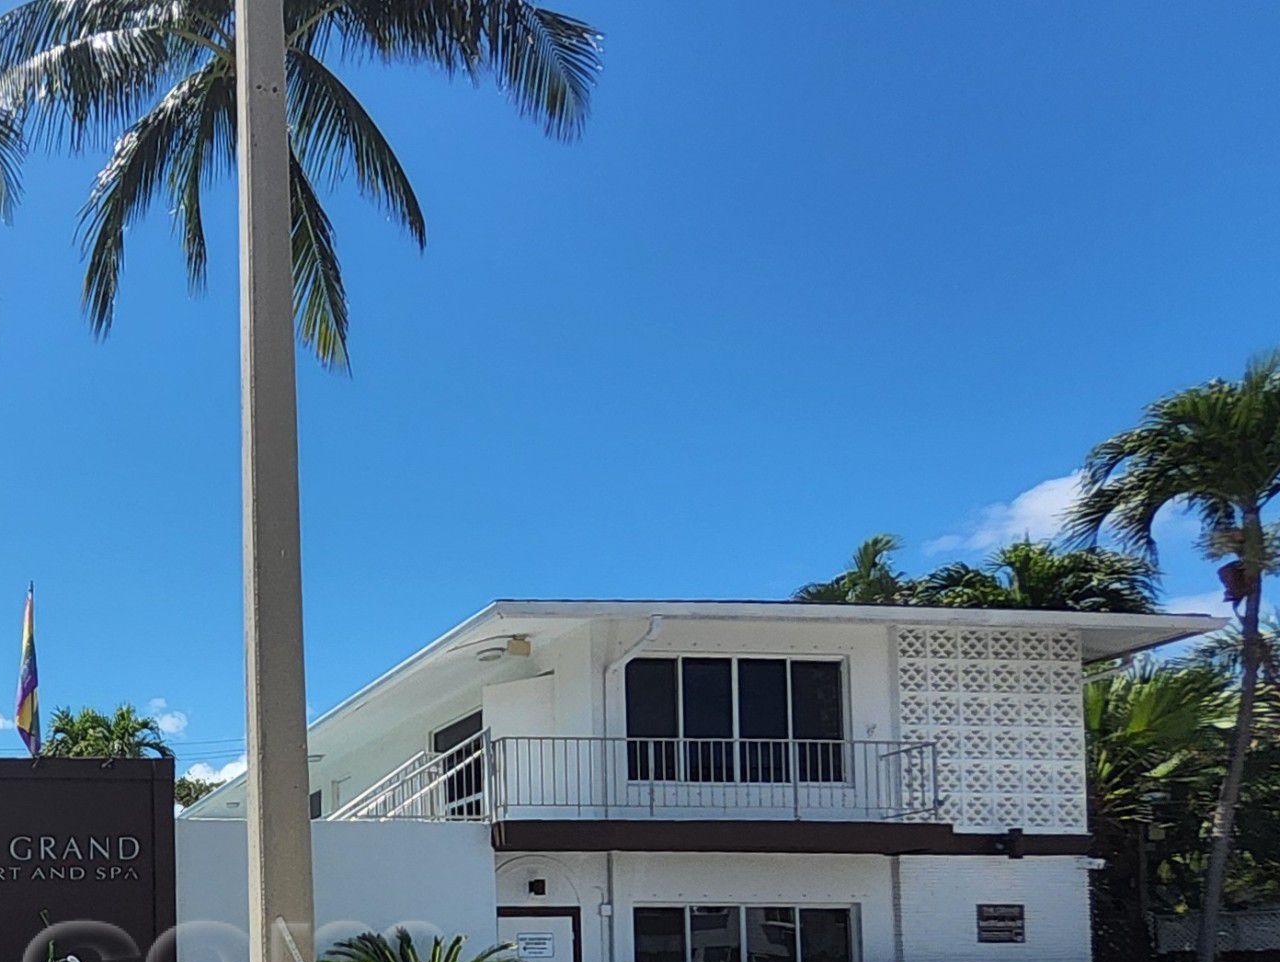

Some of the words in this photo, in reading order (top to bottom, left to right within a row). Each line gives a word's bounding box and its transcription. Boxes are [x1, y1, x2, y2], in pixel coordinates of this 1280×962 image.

[9, 836, 140, 861] GRAND
[31, 867, 85, 880] AND
[96, 867, 138, 880] SPA
